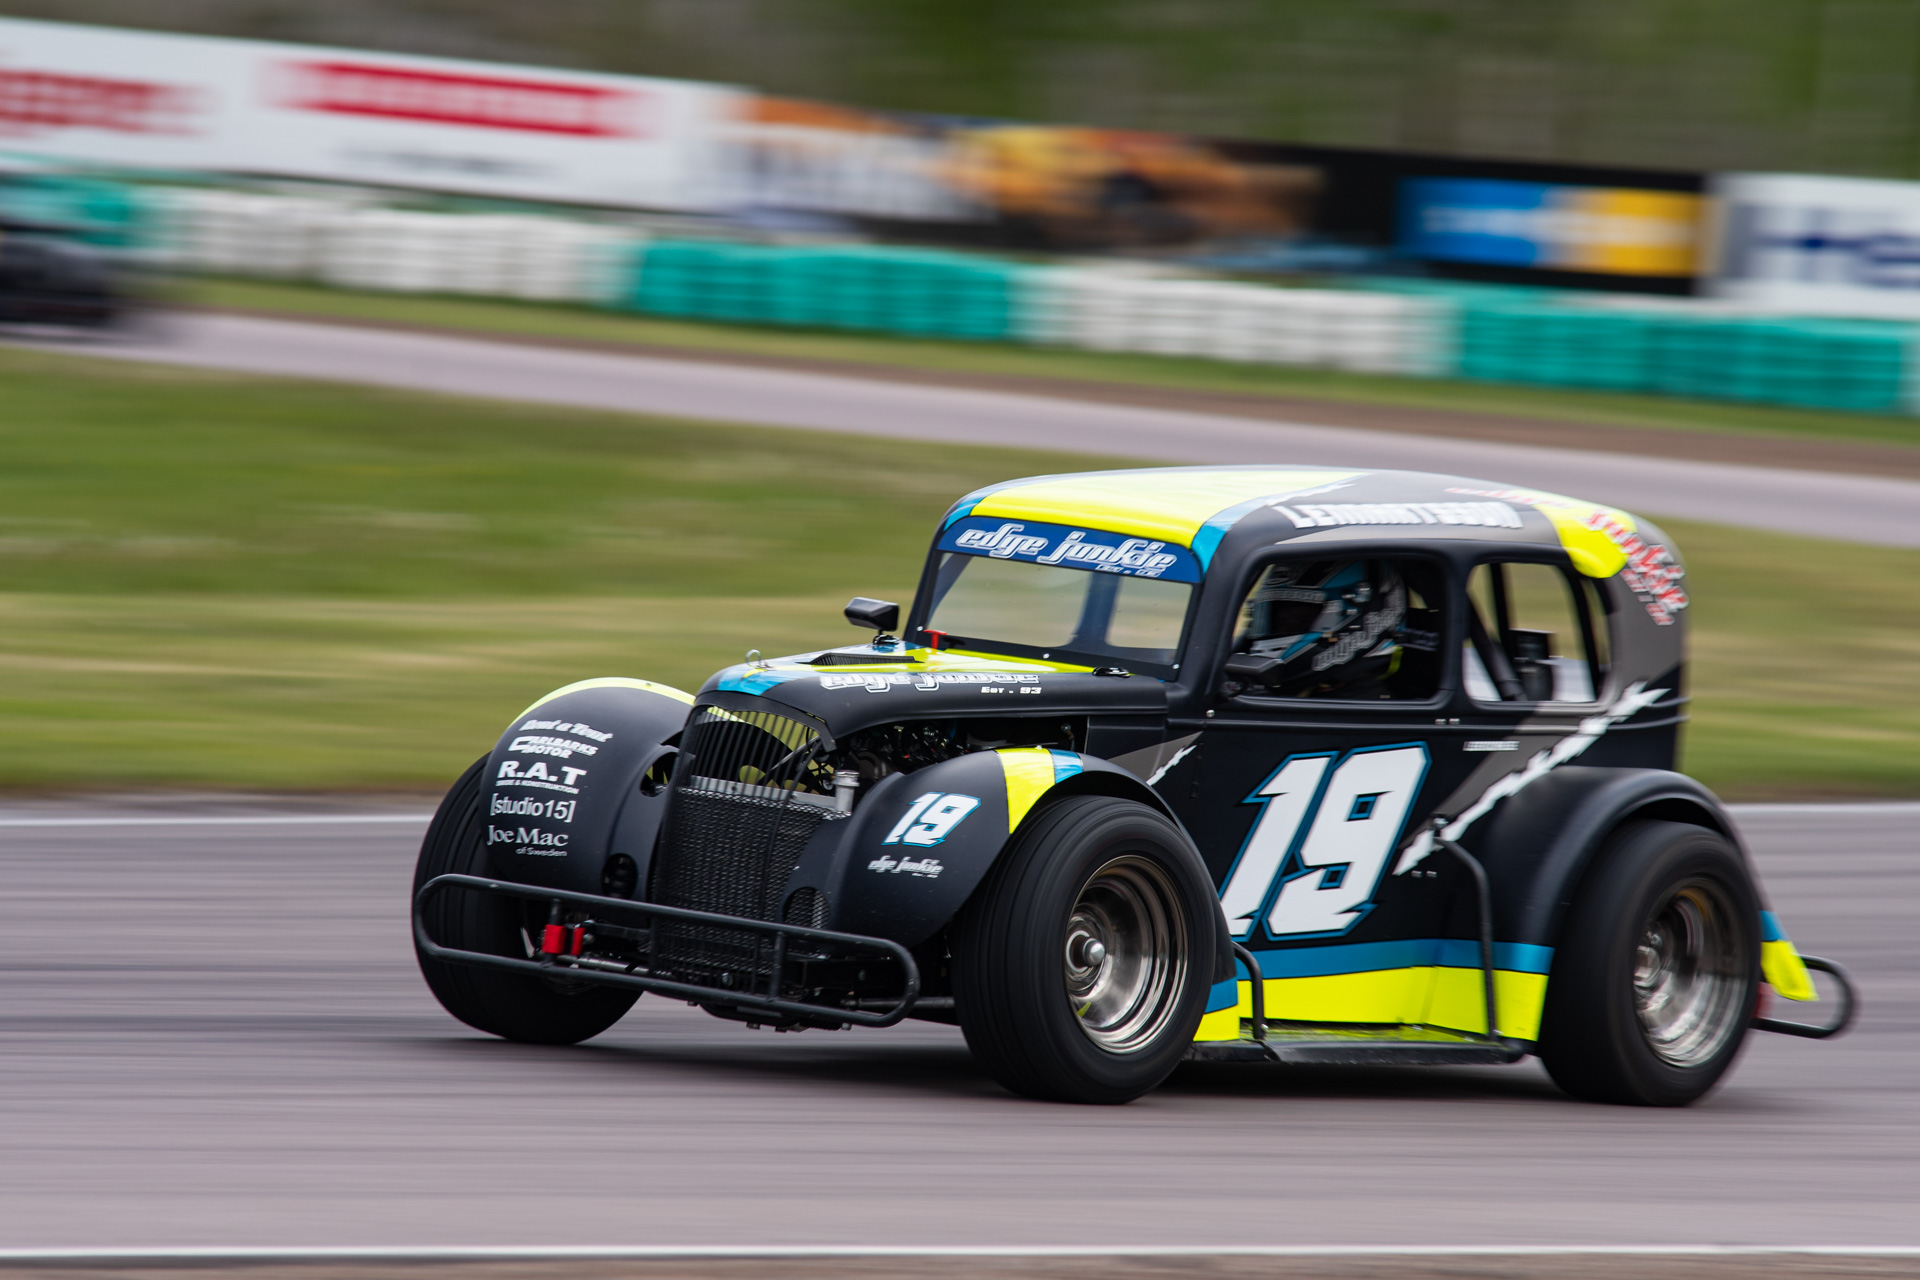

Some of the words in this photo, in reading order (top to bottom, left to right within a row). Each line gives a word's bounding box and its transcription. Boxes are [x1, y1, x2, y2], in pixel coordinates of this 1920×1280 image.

[955, 523, 1049, 558] edge
[1036, 531, 1177, 571] junkie
[520, 745, 573, 759] MOTOR
[880, 792, 982, 848] 19
[487, 824, 515, 846] Joe
[514, 826, 569, 847] Mac
[1217, 740, 1433, 942] 19
[526, 847, 568, 857] Sweden
[890, 856, 944, 875] junkie
